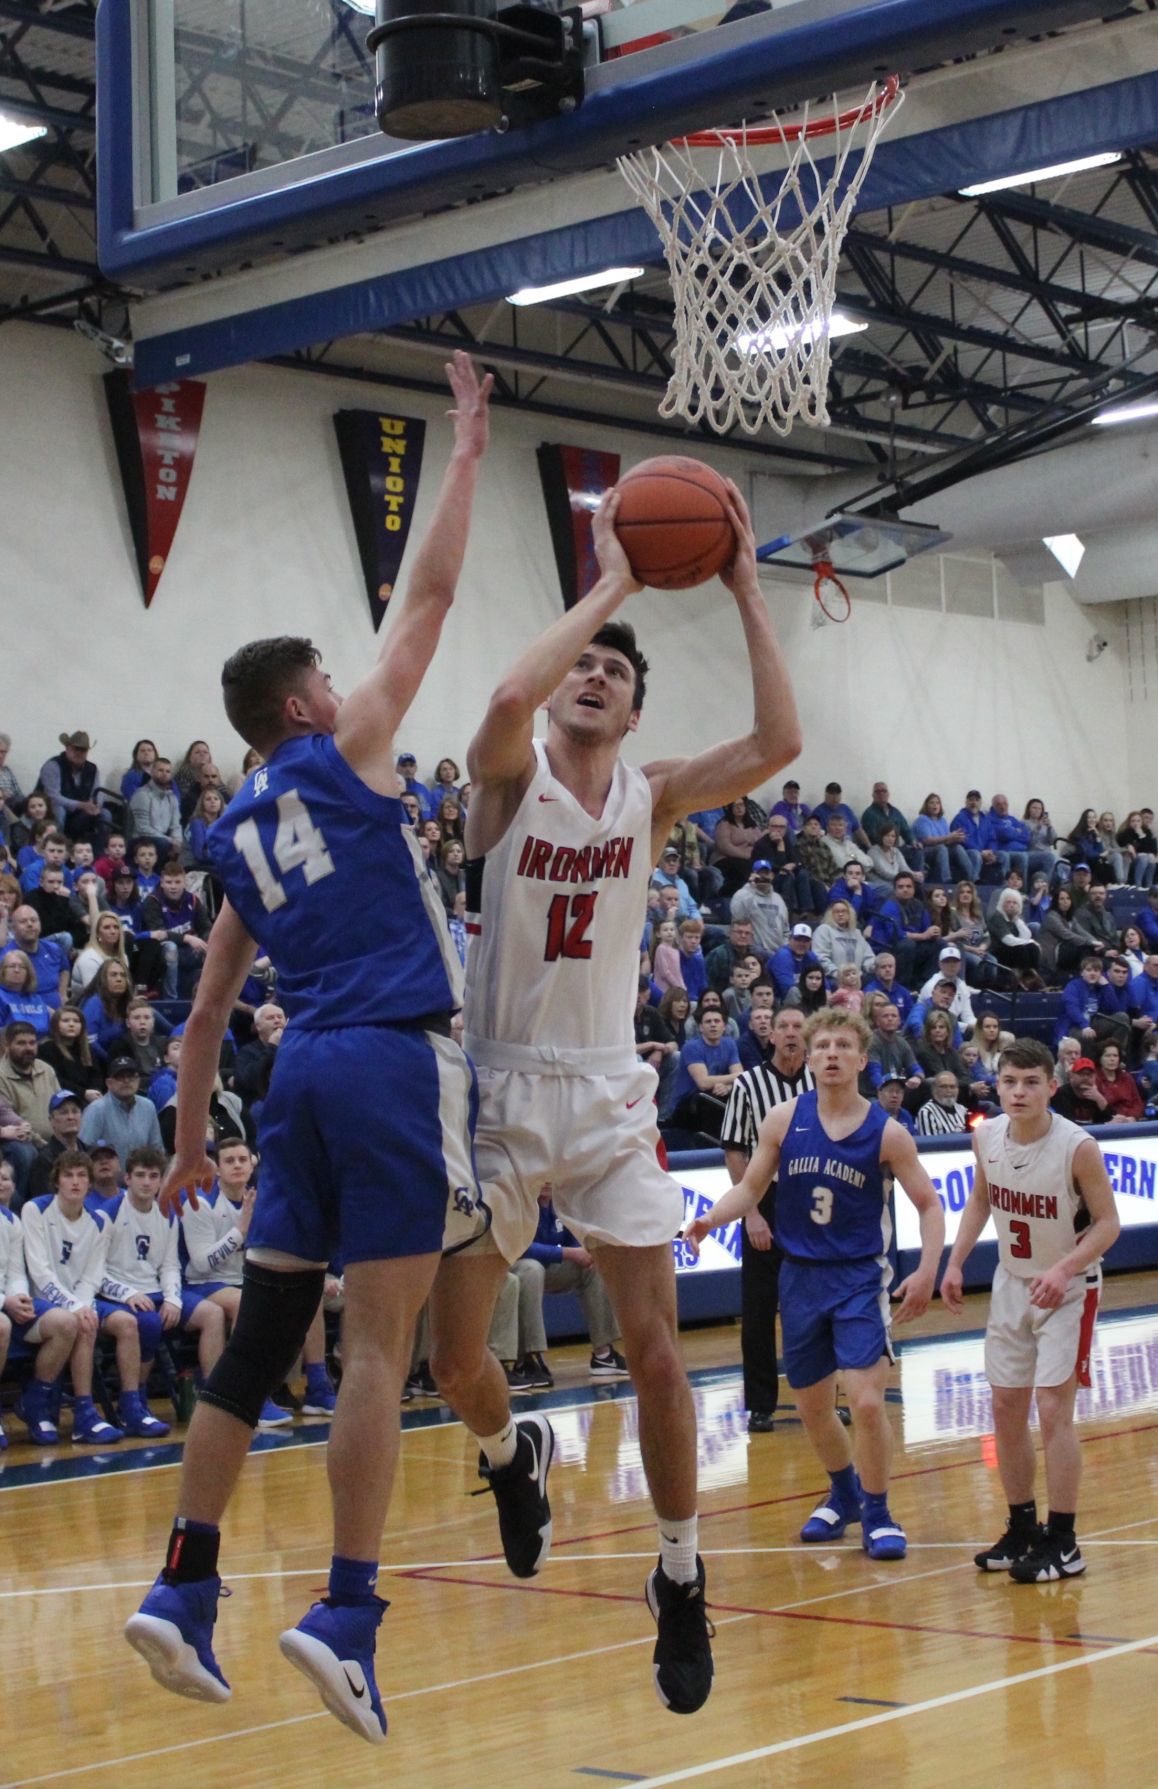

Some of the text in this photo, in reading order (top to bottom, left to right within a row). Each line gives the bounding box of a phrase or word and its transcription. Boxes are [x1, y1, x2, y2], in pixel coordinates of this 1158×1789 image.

[154, 382, 182, 501] PIKTON
[379, 417, 407, 531] UNIOTO
[233, 788, 336, 914] 14
[516, 835, 634, 884] IRONMEN
[544, 890, 599, 962] 12
[788, 1156, 867, 1189] GALLIA ACADEMY
[810, 1185, 835, 1225] 3
[207, 1236, 238, 1271] DEVILS
[1009, 1219, 1032, 1259] 3
